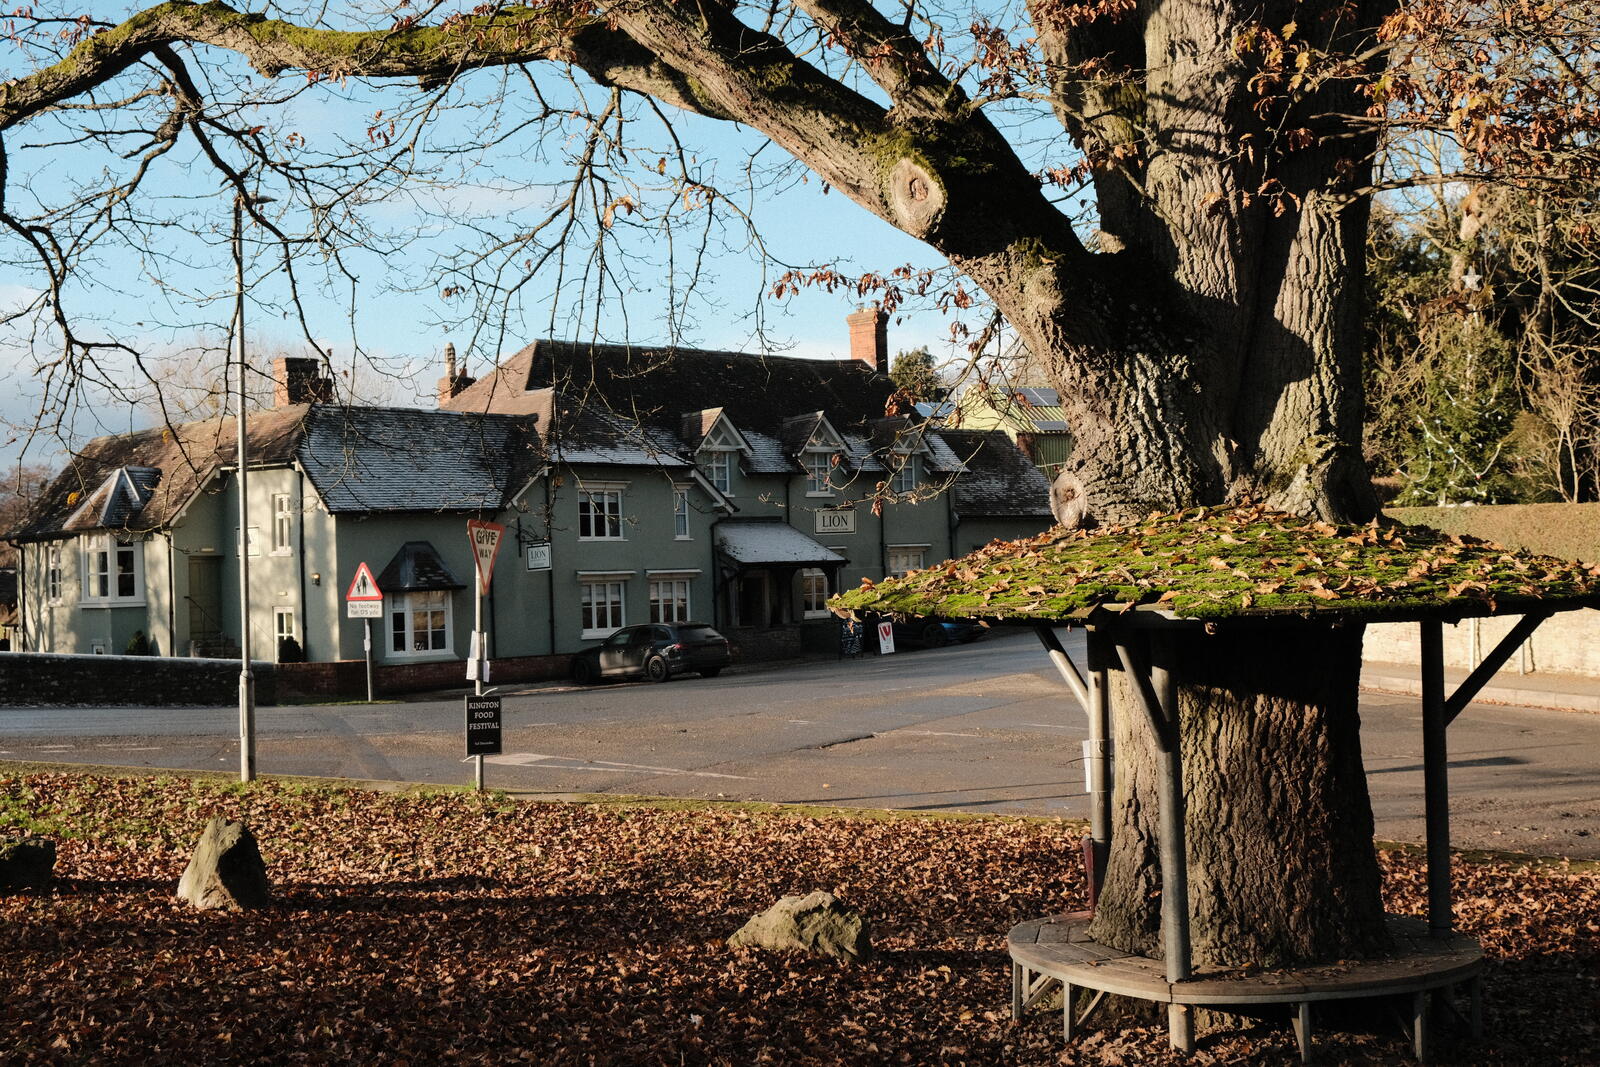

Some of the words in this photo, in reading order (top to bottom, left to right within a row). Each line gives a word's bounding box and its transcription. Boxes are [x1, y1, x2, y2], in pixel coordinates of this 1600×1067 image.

[822, 514, 848, 528] LION
[476, 530, 497, 546] GIVE
[479, 548, 492, 559] WAY
[530, 550, 546, 559] LION
[468, 701, 499, 709] KINGTON
[474, 711, 494, 719] FOOD
[469, 722, 499, 730] FESTIVAL
